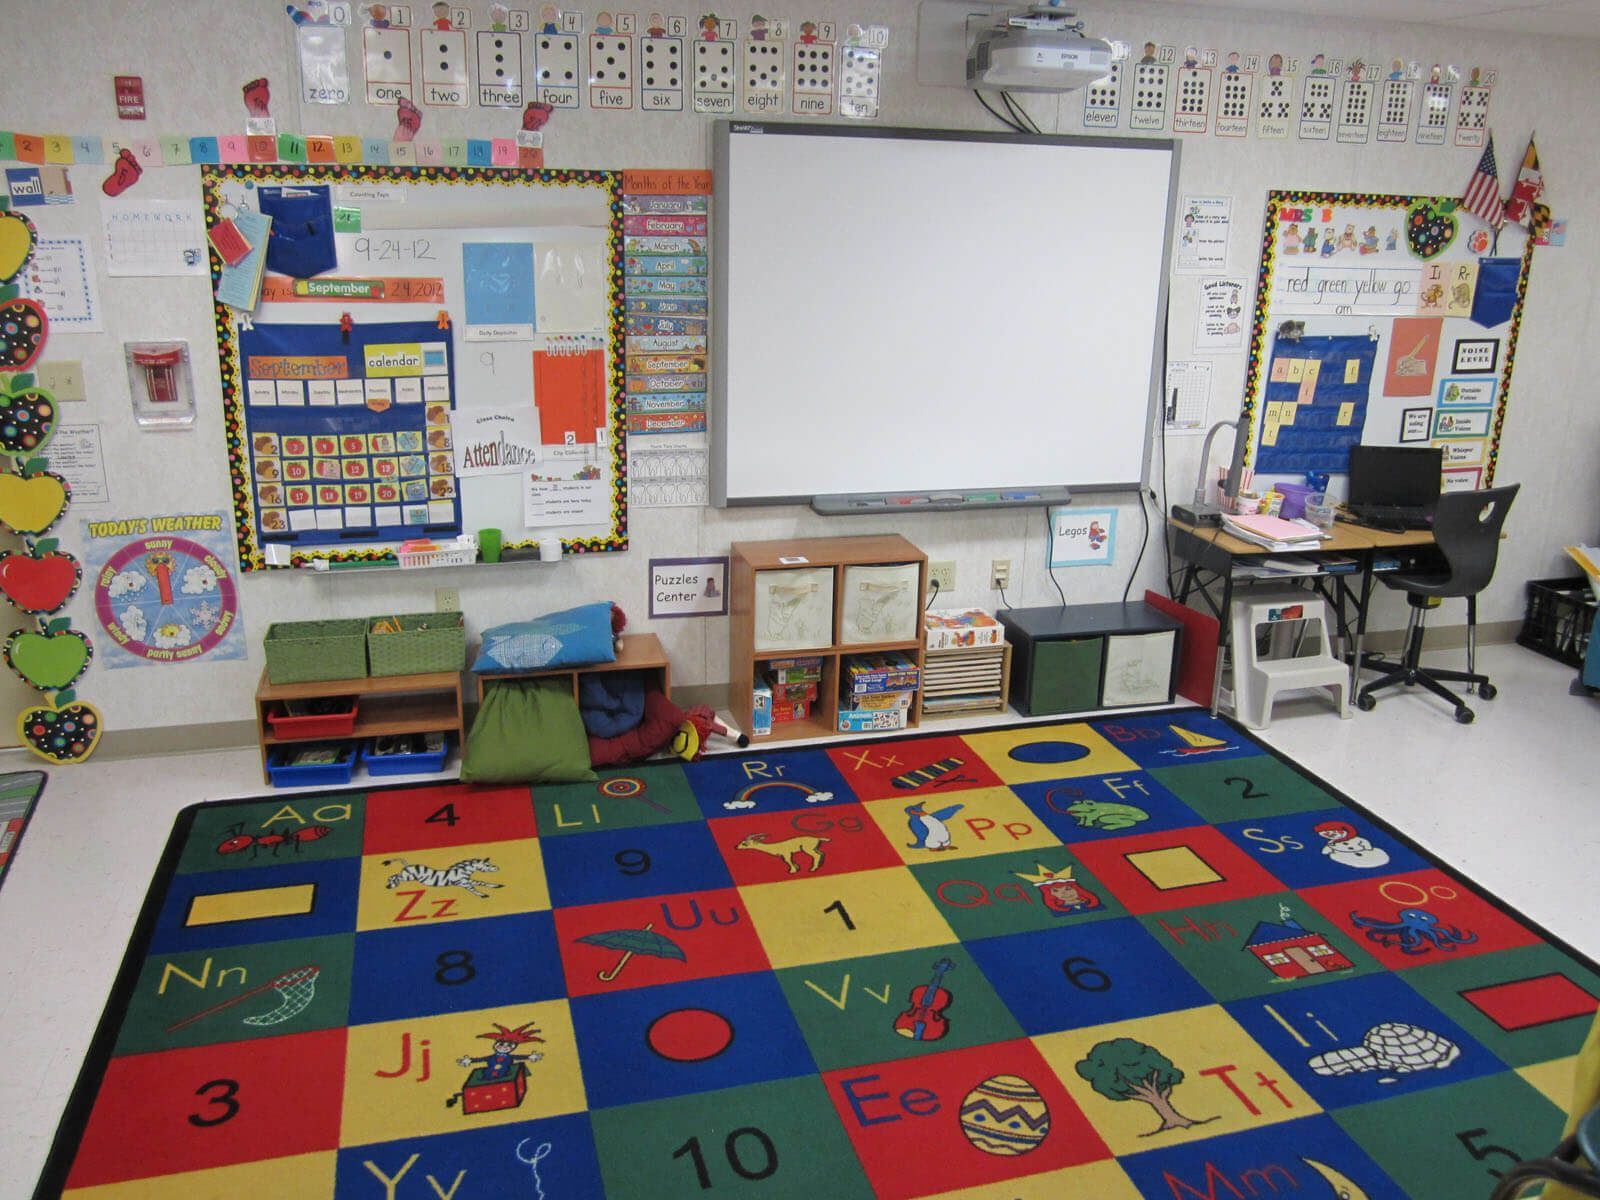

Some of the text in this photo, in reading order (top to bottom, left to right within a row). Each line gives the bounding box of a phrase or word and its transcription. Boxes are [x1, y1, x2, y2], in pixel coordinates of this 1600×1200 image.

[334, 7, 345, 22] 0
[397, 9, 404, 24] 1
[457, 11, 465, 26] 2
[514, 13, 523, 28] 3
[569, 16, 575, 30] 4
[622, 17, 630, 31] 5
[673, 19, 681, 33] 6
[725, 22, 732, 36] 7
[775, 22, 782, 35] 8
[824, 26, 831, 38] 9
[871, 31, 884, 44] 10
[1162, 49, 1173, 61] 12
[1204, 52, 1216, 65] 13
[1247, 57, 1258, 70] 14
[1287, 60, 1298, 72] 15
[1330, 62, 1340, 74] 16
[1369, 66, 1380, 78] 17
[119, 95, 141, 104] FIRE
[310, 87, 345, 100] zero
[376, 88, 402, 99] one
[430, 88, 460, 101] two
[482, 89, 520, 103] three
[542, 89, 573, 104] four
[599, 90, 623, 105] five
[653, 92, 670, 105] six
[697, 96, 730, 107] seven
[748, 93, 779, 109] eight
[800, 98, 824, 109] nine
[850, 101, 868, 113] ten
[1086, 112, 1116, 122] eleven
[1134, 115, 1160, 125] twelve
[1175, 117, 1206, 128] thirteen
[1262, 125, 1285, 134] fifteen
[22, 140, 32, 152] 2
[52, 141, 61, 153] 3
[80, 142, 90, 153] 4
[143, 145, 152, 157] 6
[172, 144, 180, 155] 7
[199, 142, 208, 154] 8
[228, 142, 236, 153] 9
[290, 141, 299, 154] 11
[313, 141, 325, 152] 12
[342, 142, 353, 153] 13
[396, 146, 407, 156] 15
[423, 146, 434, 156] 16
[448, 145, 459, 157] 17
[498, 146, 508, 155] 19
[13, 179, 40, 194] wall
[625, 175, 657, 190] Months
[662, 175, 672, 190] of
[678, 175, 690, 189] the
[650, 200, 681, 210] January
[1279, 207, 1313, 222] MRS
[647, 221, 684, 231] February
[355, 237, 436, 261] 9-24-12
[654, 242, 680, 250] March
[656, 261, 675, 271] April
[1458, 266, 1470, 280] Rr
[309, 282, 369, 296] September
[392, 282, 443, 297] 24 2012
[658, 281, 675, 291] May
[1204, 281, 1217, 290] Good
[1286, 266, 1310, 292] red
[1313, 279, 1347, 304] green
[1391, 280, 1411, 305] go
[652, 339, 678, 349] August
[369, 355, 419, 368] calendar
[647, 360, 688, 370] September
[1293, 364, 1299, 373] b
[650, 379, 684, 388] October
[647, 400, 684, 409] November
[647, 419, 686, 428] December
[271, 445, 277, 454] 2
[272, 469, 279, 479] 9
[292, 467, 302, 475] 10
[442, 463, 452, 473] 15
[270, 494, 282, 504] 16
[89, 516, 222, 538] TODAY'S WEATHER
[272, 520, 286, 530] 23
[1058, 526, 1088, 538] Legos
[145, 540, 173, 550] sunny
[204, 555, 227, 579] cloudy
[655, 573, 698, 586] Puzzles
[656, 591, 697, 602] Center
[146, 644, 203, 660] partly sunny
[843, 750, 904, 771] Xx
[741, 760, 788, 780] Rr
[1102, 777, 1151, 800] Ff
[1224, 777, 1268, 800] 2
[260, 803, 352, 828] Aa
[425, 803, 460, 827] 4
[791, 812, 863, 834] Gg
[965, 817, 1033, 841] Pp
[1242, 828, 1304, 853] Ss
[614, 849, 651, 876] 9
[936, 879, 1034, 909] Qq
[1379, 881, 1457, 905] Oo
[394, 889, 459, 923] Zz
[661, 899, 740, 931] Uu
[823, 900, 857, 931] 1
[1157, 915, 1239, 945] Hh
[435, 949, 475, 986] 8
[157, 957, 248, 995] Nn
[1062, 956, 1112, 993] 6
[804, 974, 890, 1011] Vv
[375, 1032, 431, 1083] Jj
[1199, 1063, 1293, 1117] Tt
[187, 1078, 241, 1127] 3
[840, 1074, 941, 1128] Ee
[672, 1126, 779, 1190] 10
[1456, 1127, 1524, 1180] 5
[1162, 1160, 1300, 1200] Mm
